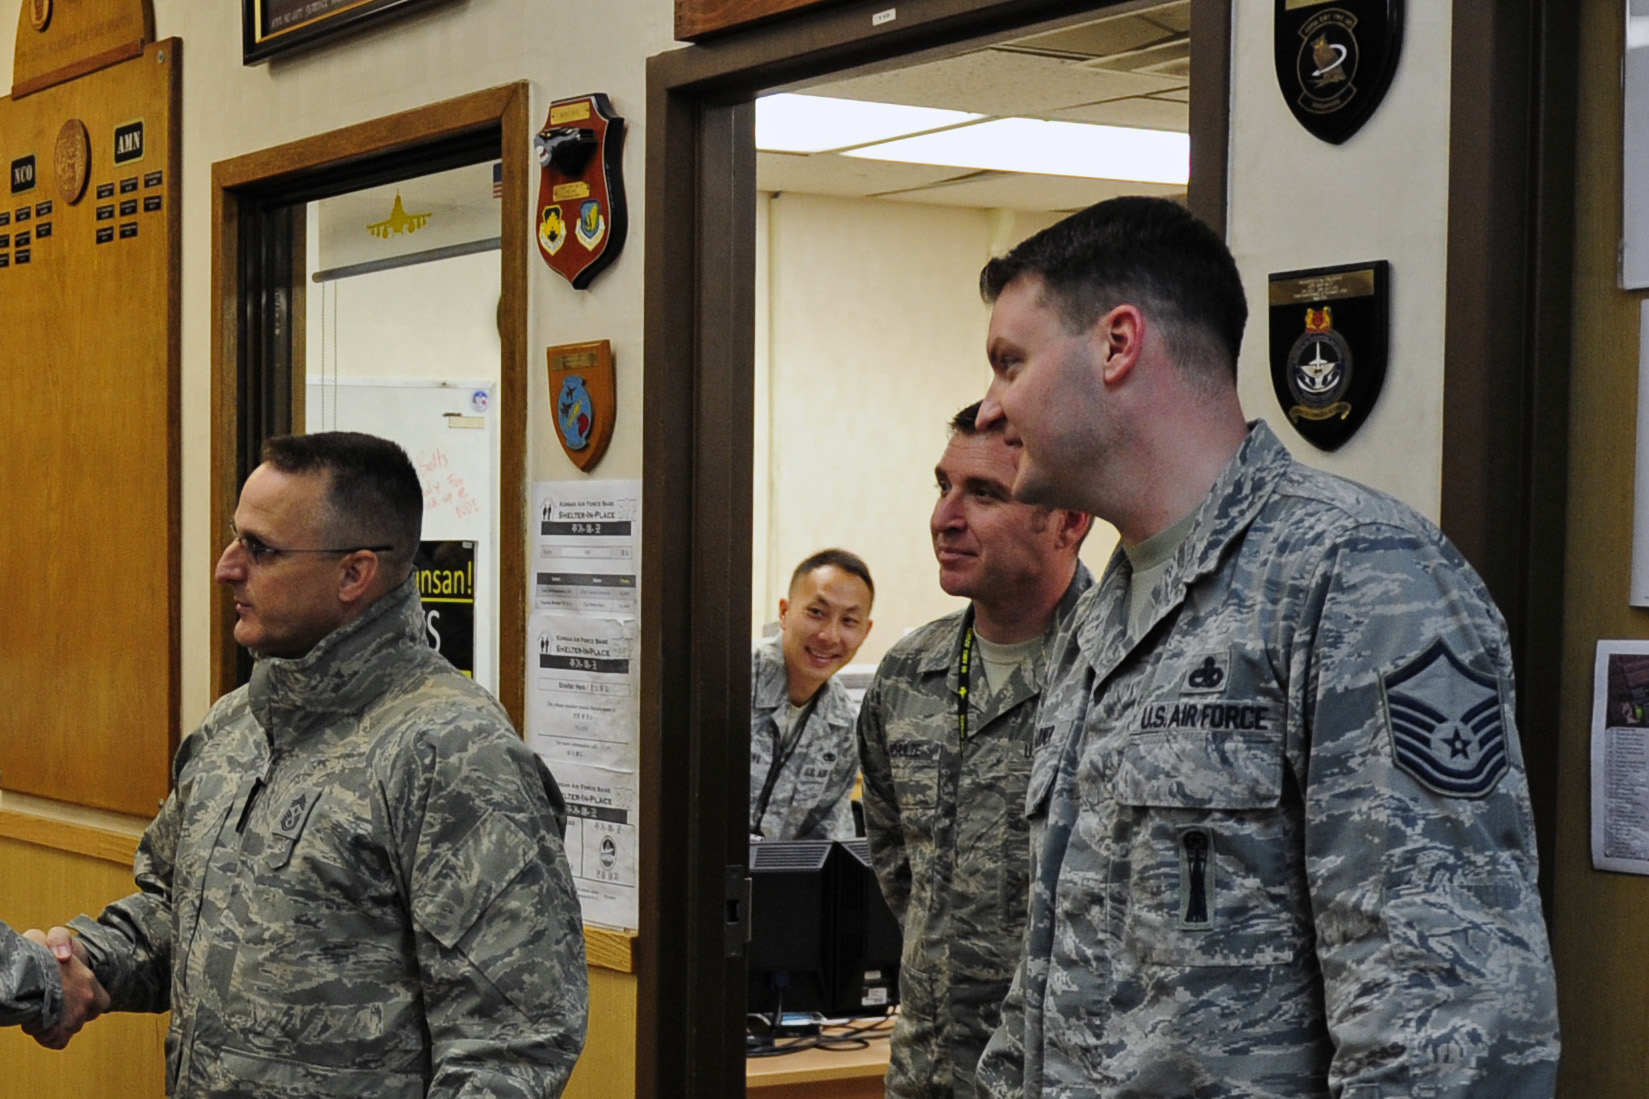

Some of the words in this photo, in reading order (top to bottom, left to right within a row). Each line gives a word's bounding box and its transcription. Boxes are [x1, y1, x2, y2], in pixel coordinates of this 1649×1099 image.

[117, 131, 141, 154] AMN
[14, 164, 33, 185] NCO
[1141, 705, 1167, 729] U.S.
[1167, 704, 1198, 728] AIR
[1201, 704, 1270, 730] FORCE
